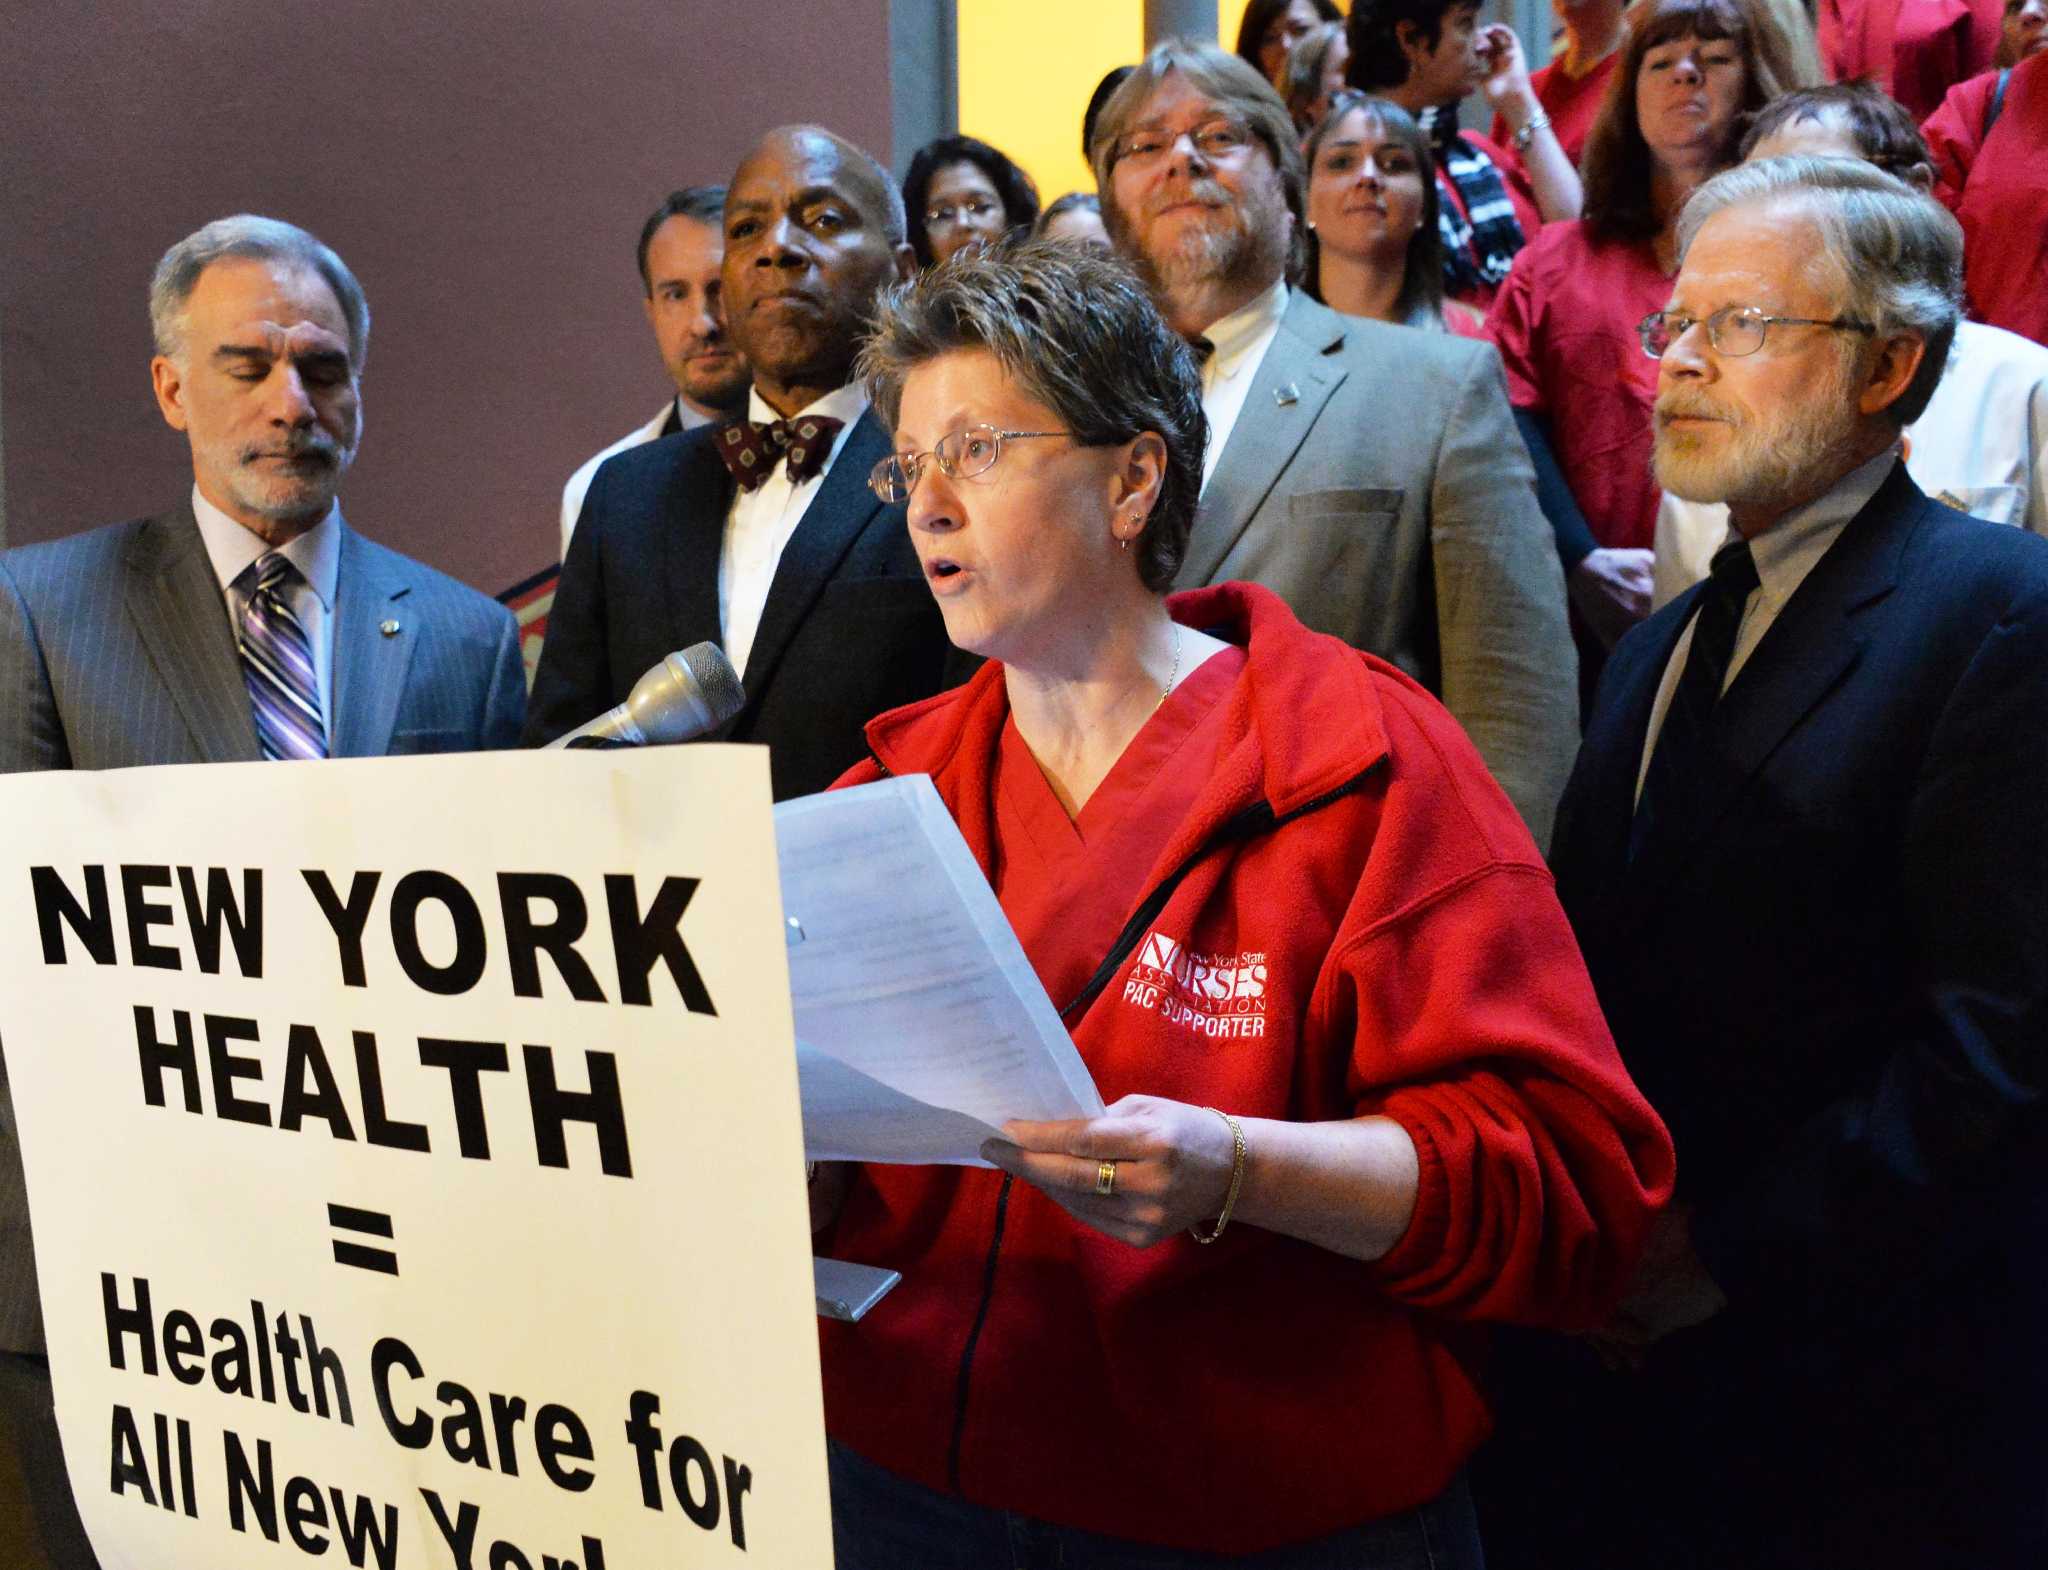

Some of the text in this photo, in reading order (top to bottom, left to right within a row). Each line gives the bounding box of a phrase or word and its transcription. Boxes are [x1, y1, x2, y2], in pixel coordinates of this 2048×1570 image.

[31, 865, 263, 978] NEW
[301, 869, 719, 1018] YORK
[1122, 980, 1265, 1038] PAC SUPPORTER
[133, 1006, 634, 1179] HEALTH
[101, 1272, 354, 1427] Health
[371, 1337, 596, 1493] Care
[625, 1390, 752, 1552] for
[110, 1405, 199, 1519] All
[224, 1430, 399, 1570] New
